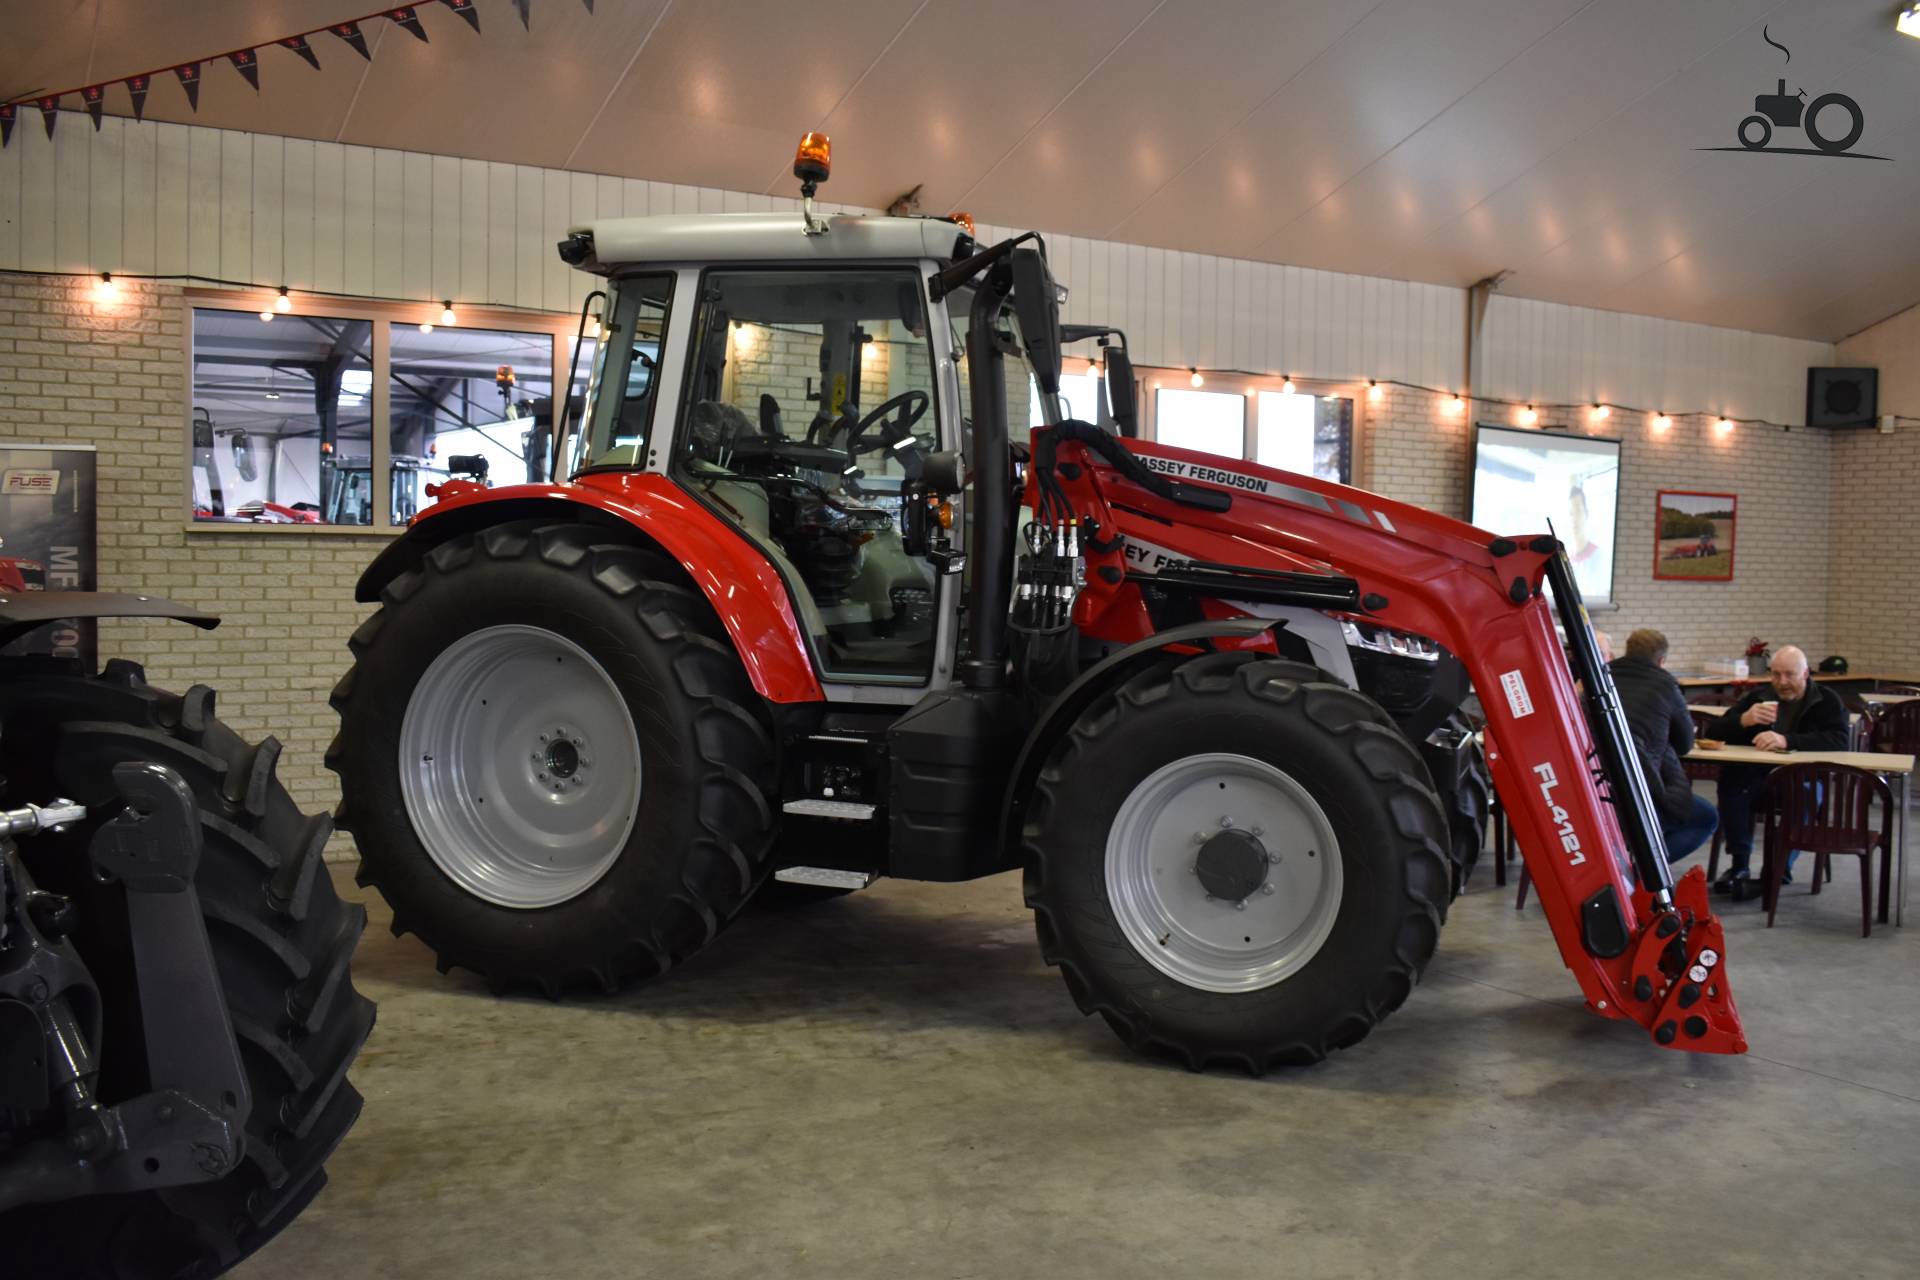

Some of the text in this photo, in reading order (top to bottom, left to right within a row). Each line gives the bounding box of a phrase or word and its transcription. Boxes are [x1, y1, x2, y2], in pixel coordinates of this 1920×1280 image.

[9, 477, 53, 487] FUSE
[1189, 466, 1269, 493] FERGUSON
[1121, 542, 1150, 562] EY
[49, 546, 79, 588] MF
[1532, 762, 1587, 866] FL.4121
